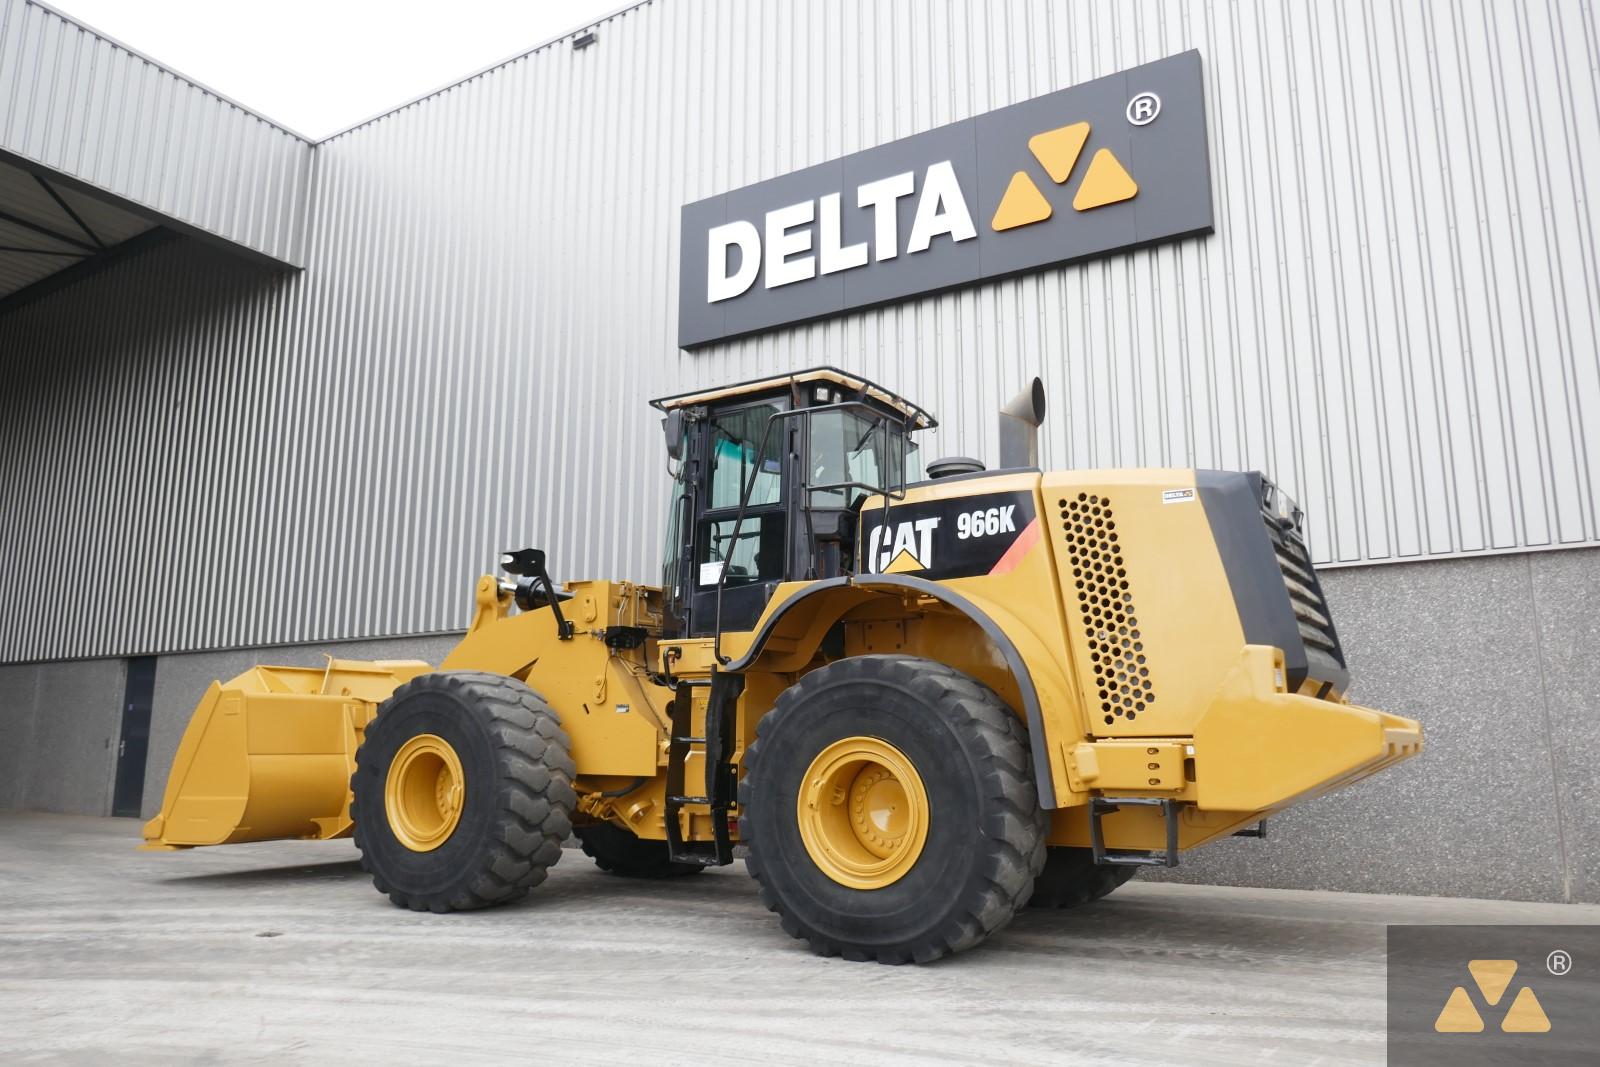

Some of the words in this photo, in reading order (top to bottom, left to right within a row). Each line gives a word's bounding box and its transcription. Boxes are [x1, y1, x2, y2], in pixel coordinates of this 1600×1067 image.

[708, 160, 977, 303] DELTA
[868, 516, 938, 574] CAT
[957, 504, 1016, 540] 966K
